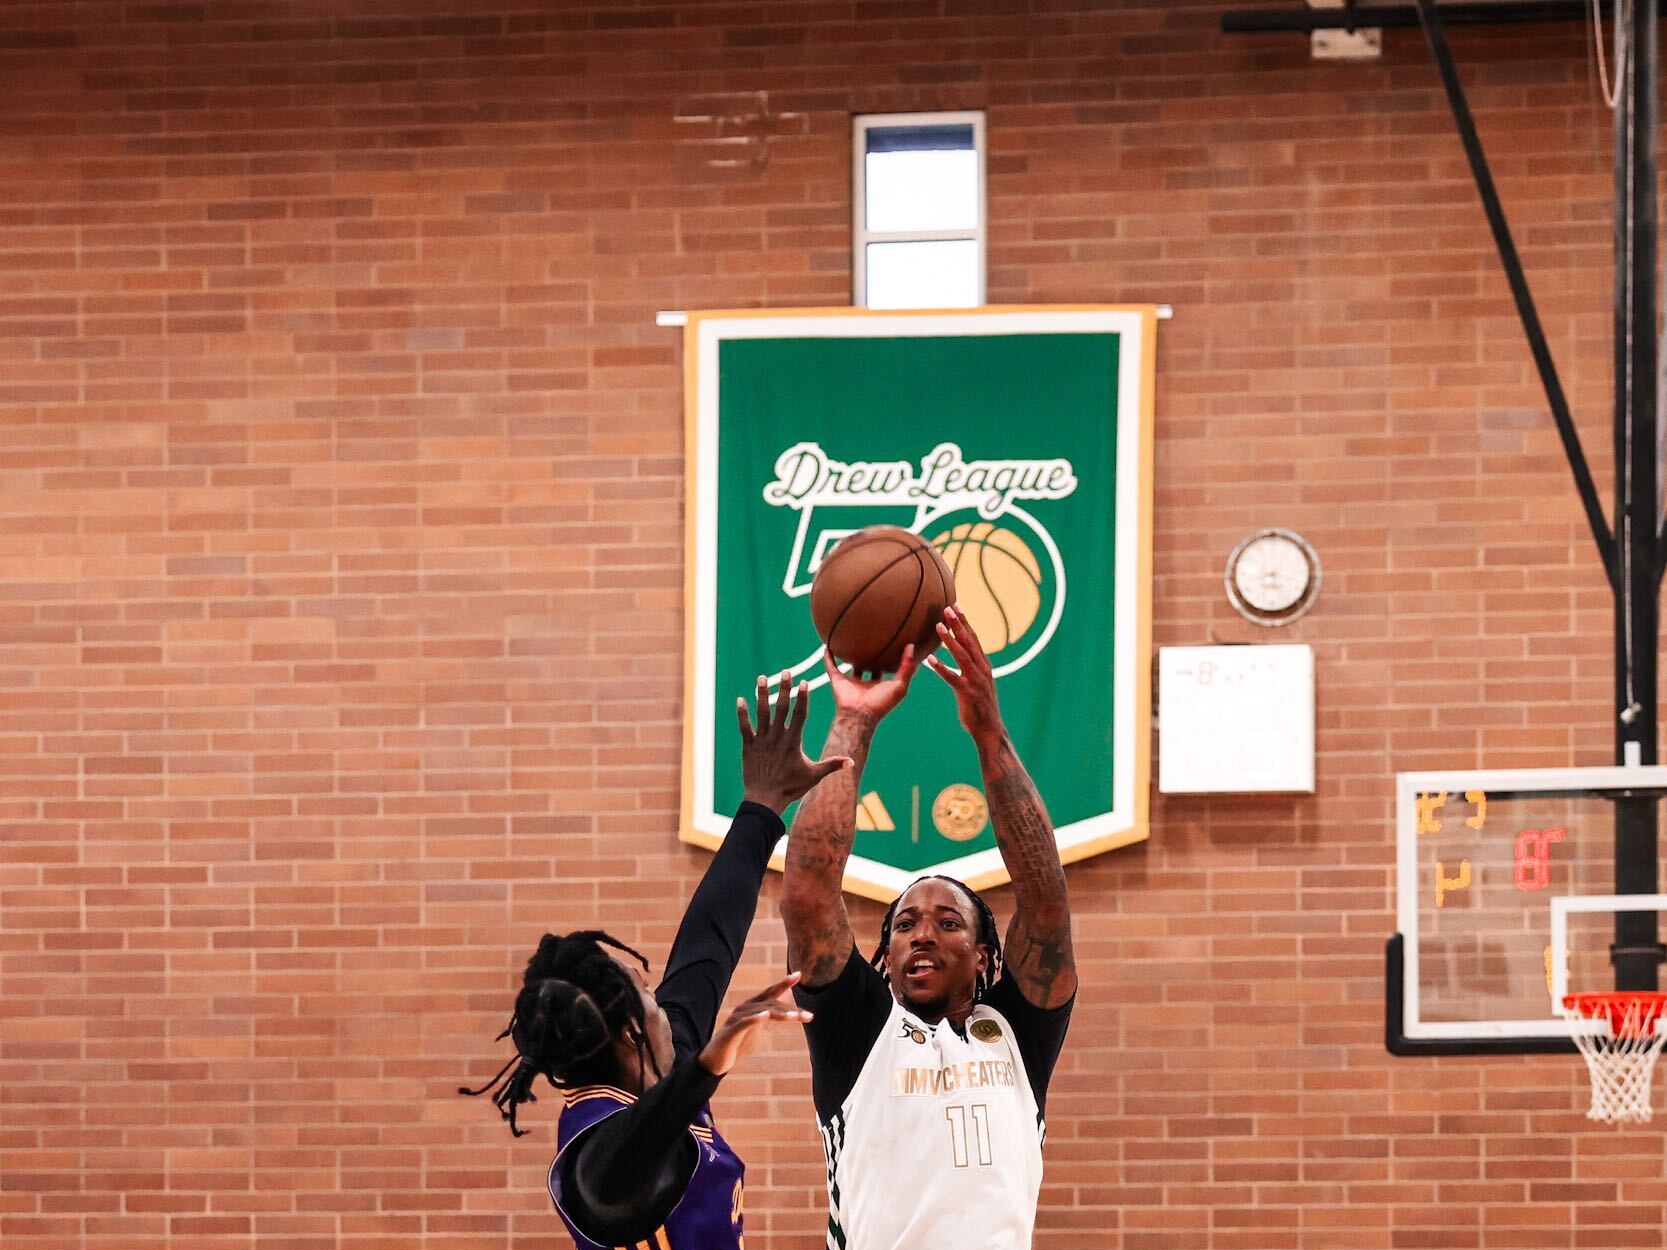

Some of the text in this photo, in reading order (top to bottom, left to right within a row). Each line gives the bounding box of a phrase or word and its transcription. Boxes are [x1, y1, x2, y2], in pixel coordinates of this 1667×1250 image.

[768, 446, 1070, 514] Drew League
[947, 1104, 992, 1167] 11
